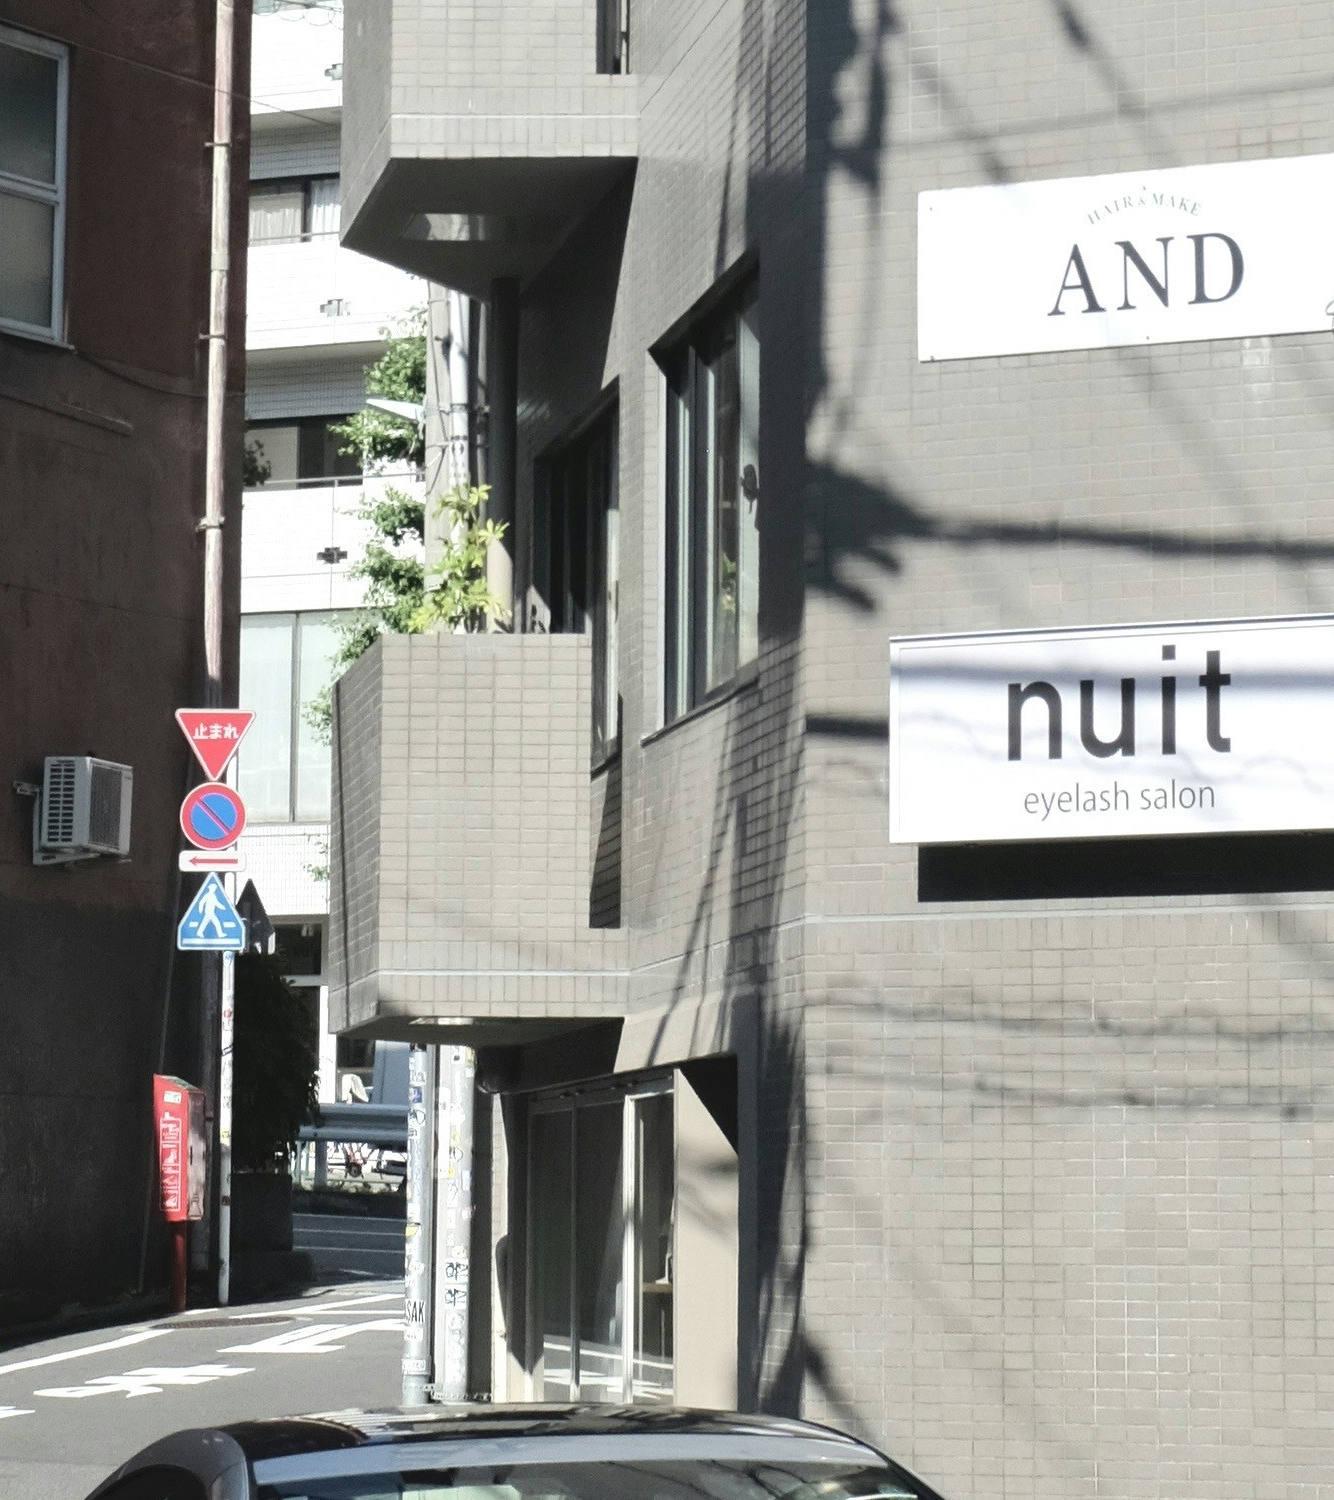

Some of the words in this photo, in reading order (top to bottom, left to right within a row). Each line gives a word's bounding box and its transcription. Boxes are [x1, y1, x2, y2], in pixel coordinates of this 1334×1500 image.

[1152, 193, 1202, 216] MAKE
[1048, 231, 1245, 317] AND
[1007, 644, 1231, 761] nuit
[192, 722, 240, 740] 止まれ
[1023, 781, 1130, 821] eyelash
[1140, 779, 1216, 812] salon
